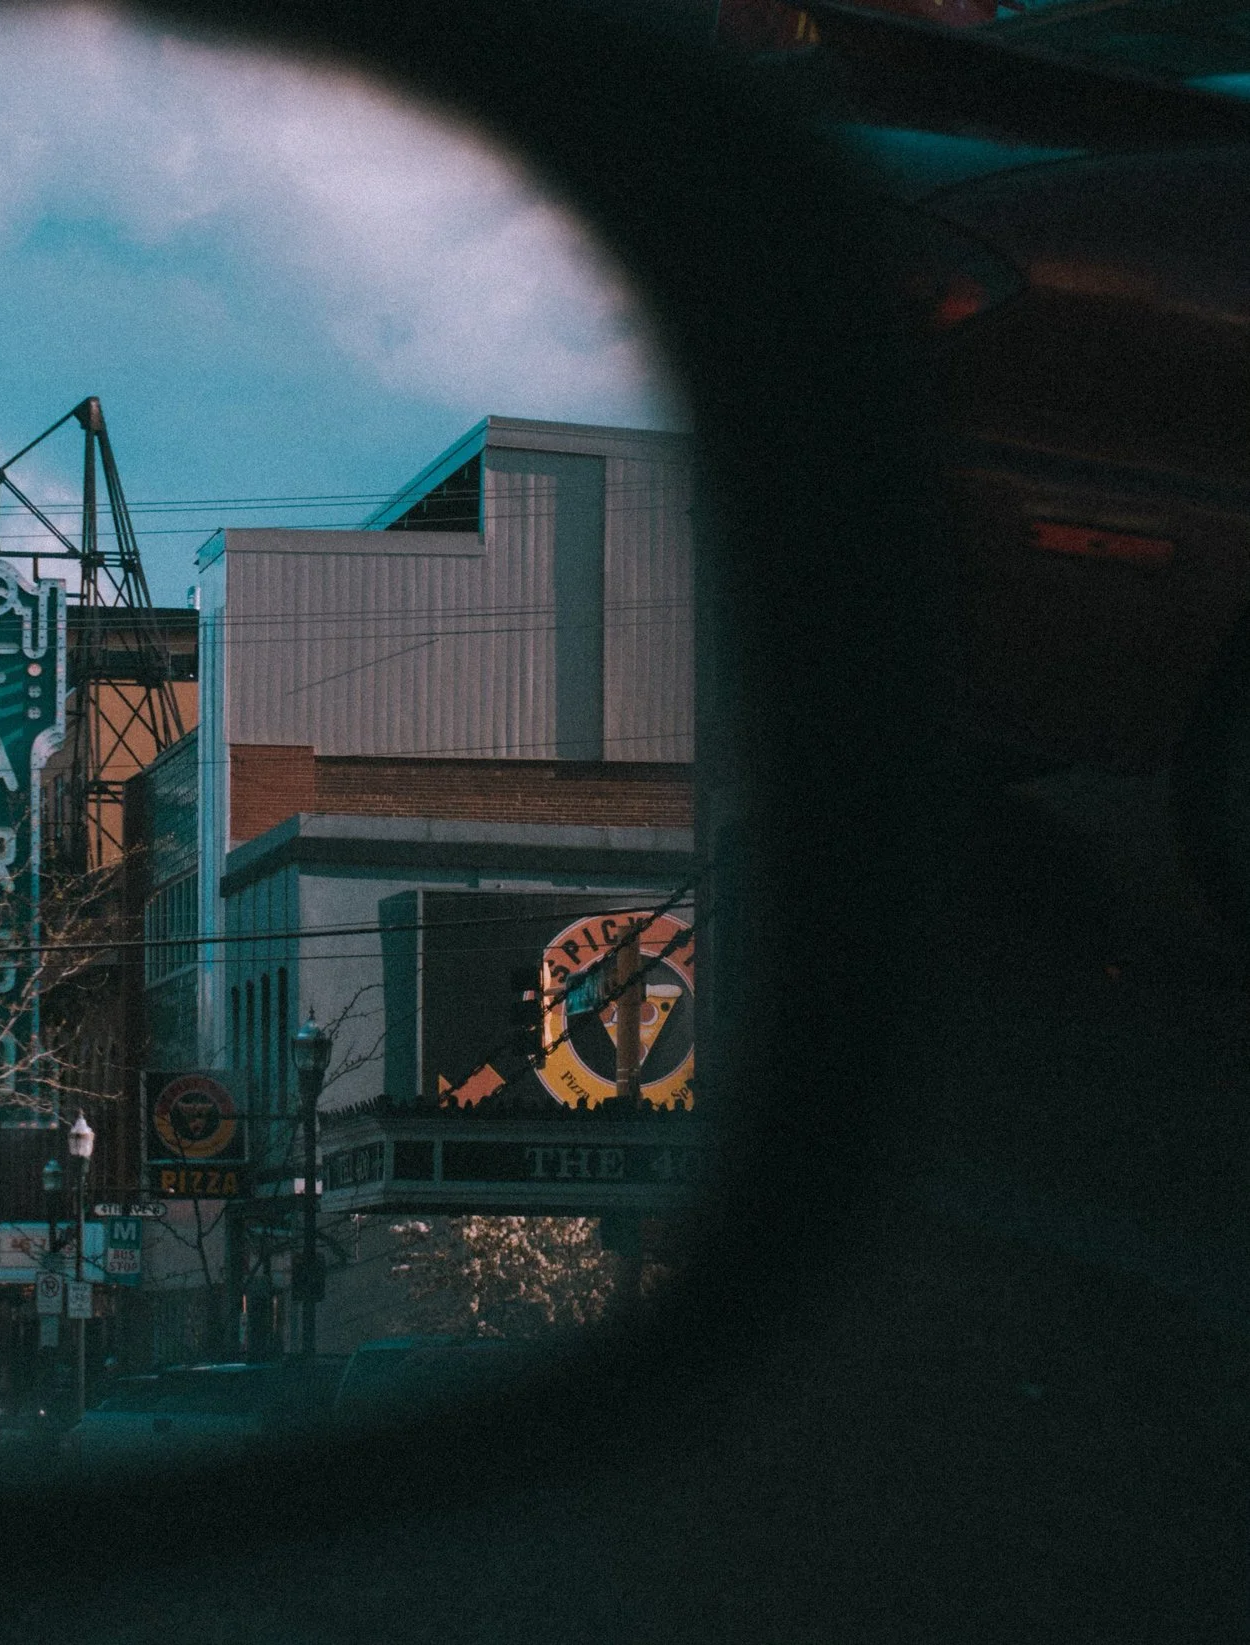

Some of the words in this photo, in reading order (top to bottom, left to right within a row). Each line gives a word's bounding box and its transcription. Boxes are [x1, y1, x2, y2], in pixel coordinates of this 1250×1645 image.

[525, 1147, 625, 1178] THE
[160, 1169, 238, 1194] PIZZA
[114, 1222, 136, 1240] M
[113, 1250, 135, 1260] BUS
[109, 1261, 138, 1272] STOP
